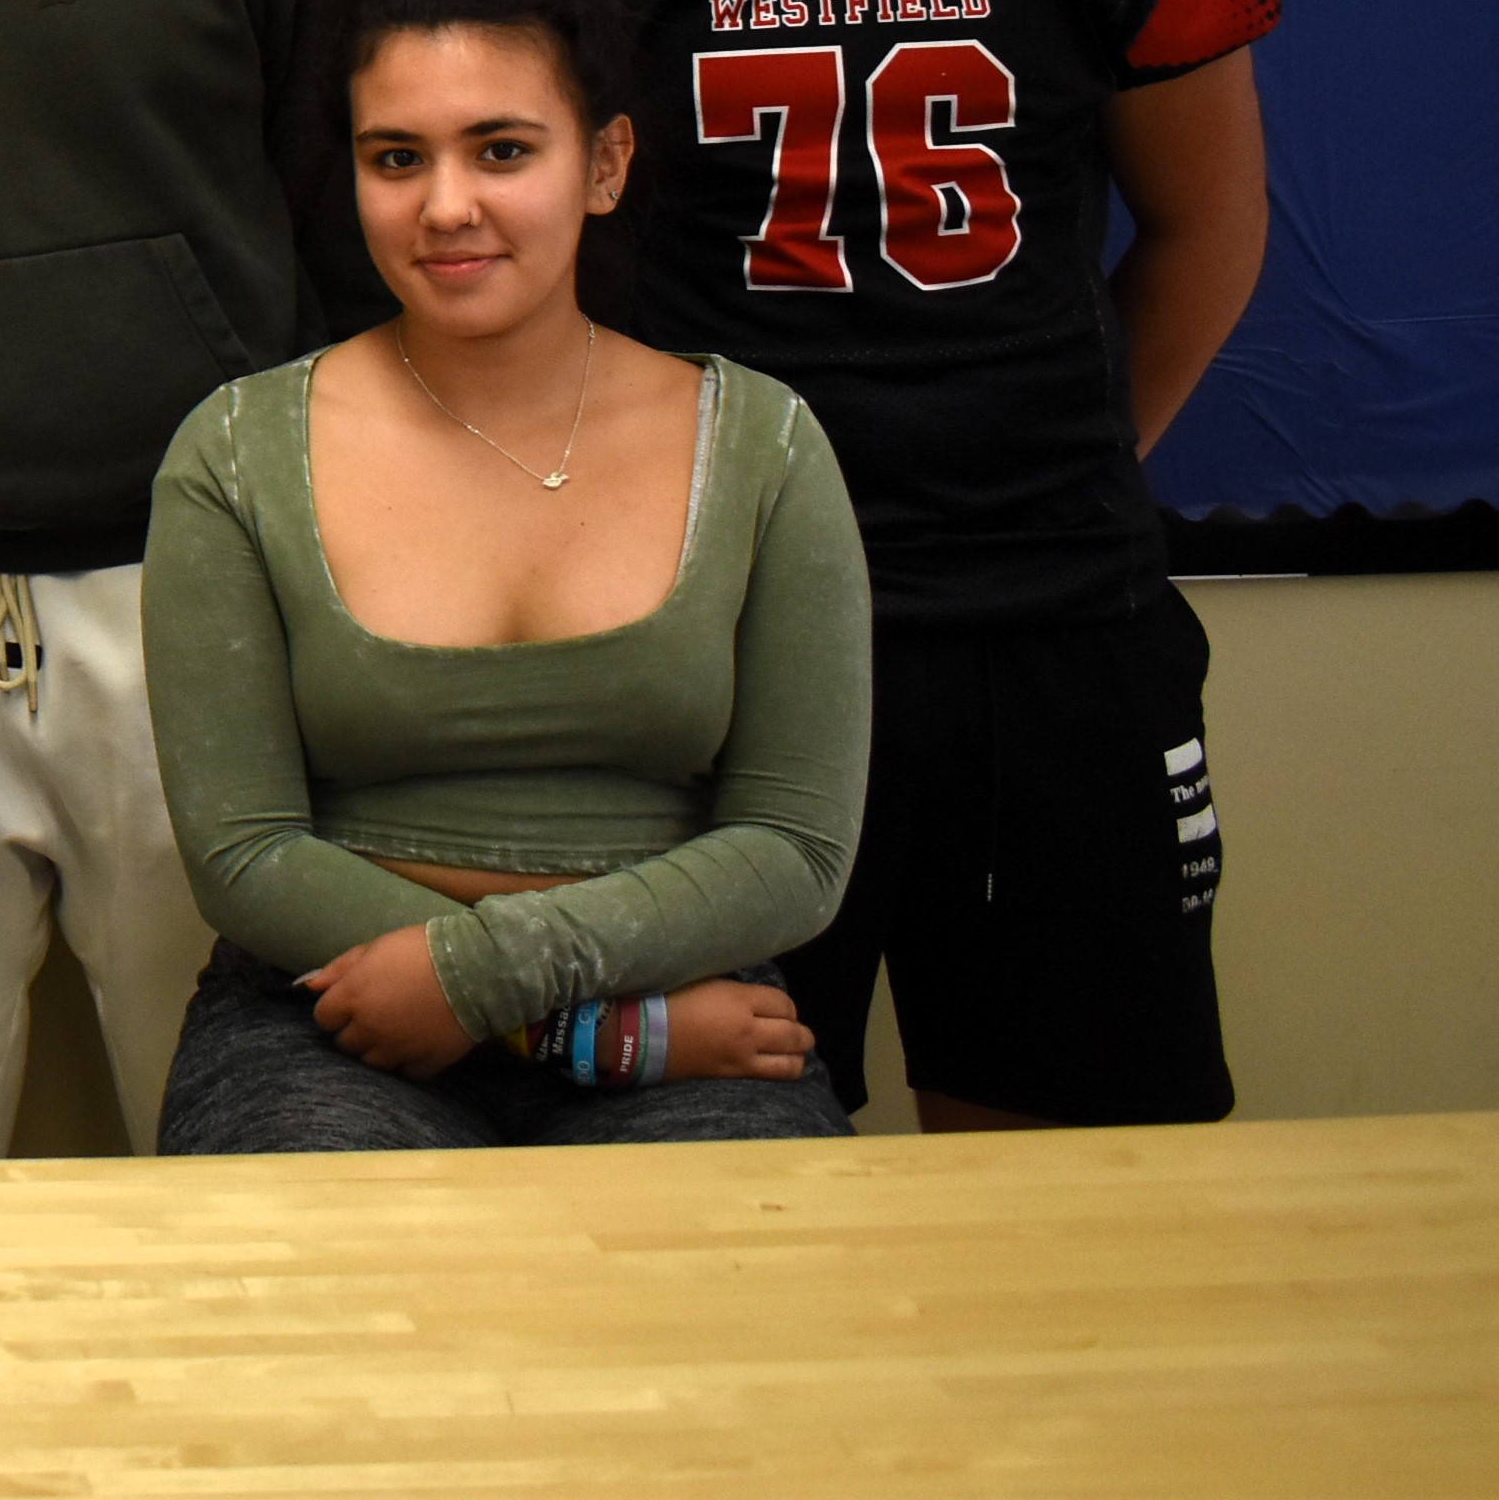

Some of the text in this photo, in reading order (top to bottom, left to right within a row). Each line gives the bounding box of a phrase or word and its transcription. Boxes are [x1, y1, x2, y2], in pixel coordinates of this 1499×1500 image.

[692, 39, 1021, 292] 76
[1170, 785, 1195, 803] The
[620, 1035, 634, 1073] PRIDE
